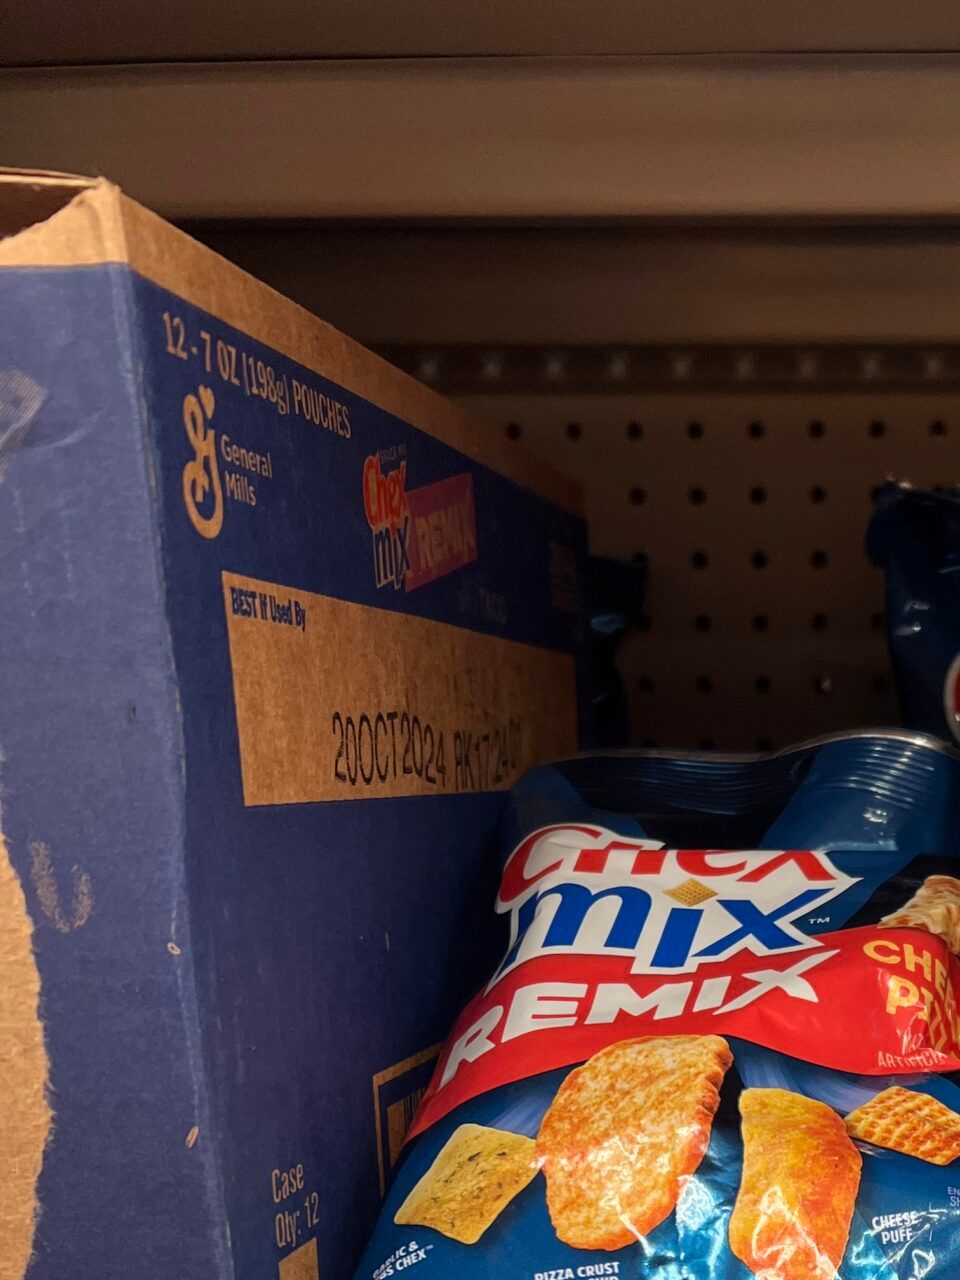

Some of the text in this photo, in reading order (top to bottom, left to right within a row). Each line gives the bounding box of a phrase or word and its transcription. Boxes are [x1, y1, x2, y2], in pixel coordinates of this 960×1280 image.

[163, 312, 352, 440] 12 7 OZ (198g) POUCHES
[220, 434, 273, 480] General
[225, 469, 257, 507] Mills
[363, 453, 408, 533] Chex
[373, 514, 412, 590] mix
[414, 498, 476, 571] REMIX
[230, 586, 257, 619] BEST
[269, 595, 293, 626] Used
[294, 600, 306, 633] By
[492, 880, 834, 970] mix
[437, 949, 840, 1094] REMIX
[271, 1163, 304, 1204] Case
[275, 1191, 320, 1249] Qty: 12
[871, 1210, 918, 1232] CHEESE
[881, 1227, 913, 1245] PUFF
[576, 1262, 620, 1278] CRUST
